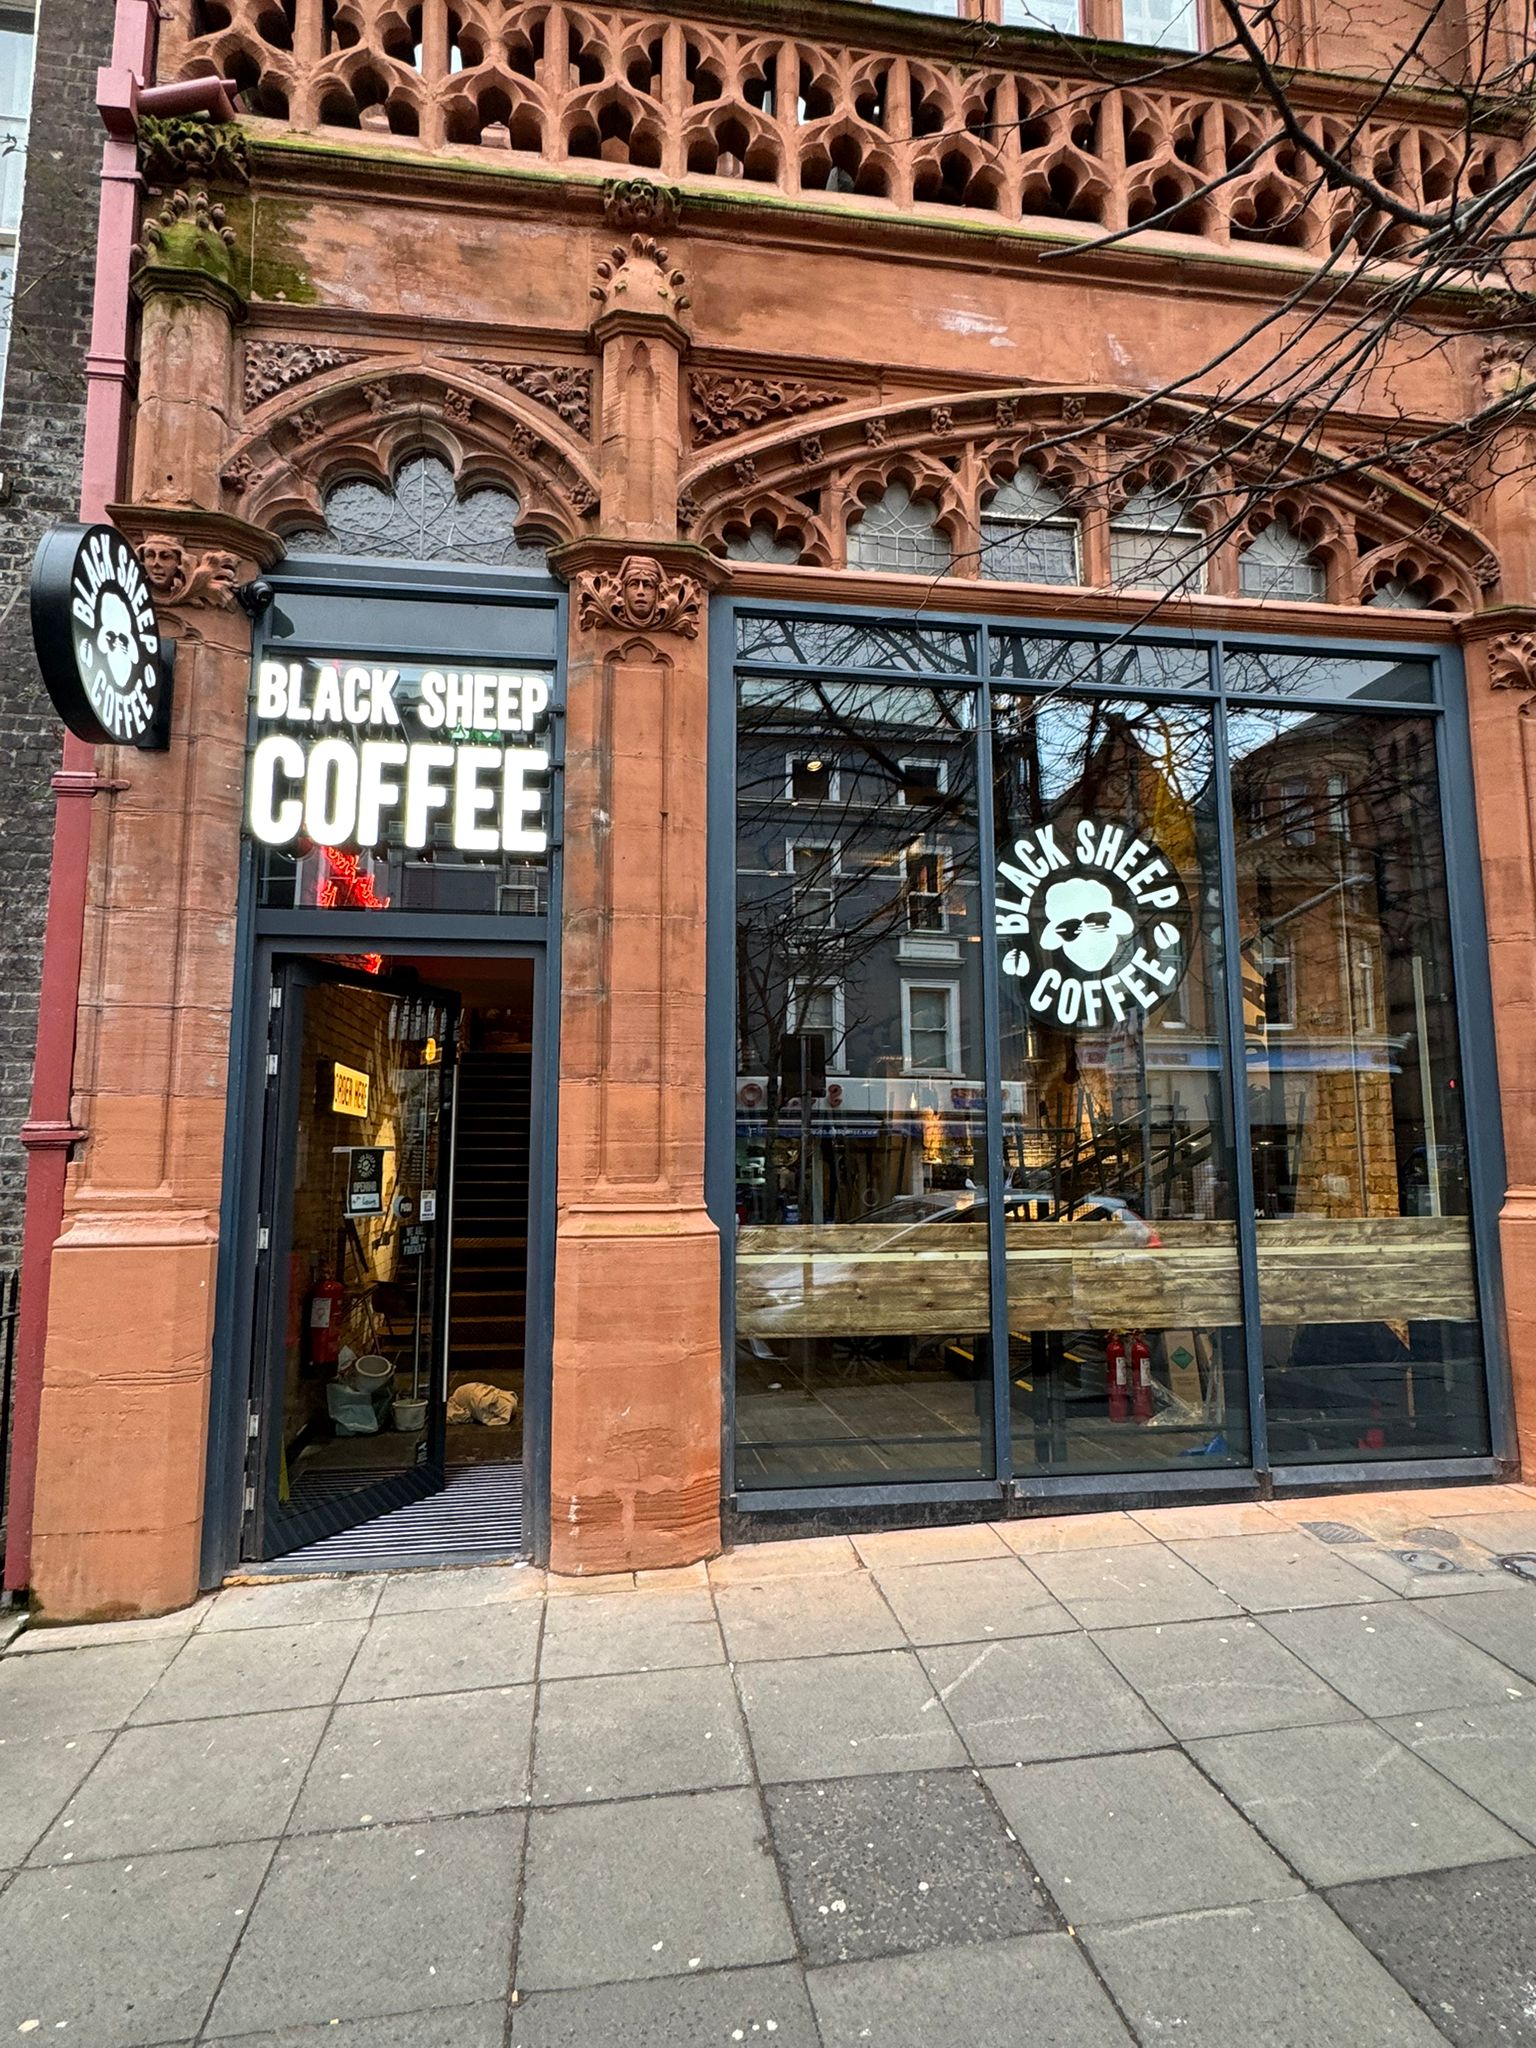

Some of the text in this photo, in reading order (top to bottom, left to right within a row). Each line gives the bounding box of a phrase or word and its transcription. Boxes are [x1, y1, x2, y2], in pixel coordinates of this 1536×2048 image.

[72, 533, 158, 655] BLACK SHEEP
[91, 669, 154, 739] COFFEE
[257, 661, 549, 732] BLACK SHEEP
[250, 735, 550, 853] COFFEE
[995, 819, 1180, 935] BLACK SHEEP
[1029, 946, 1177, 1028] COFFEE
